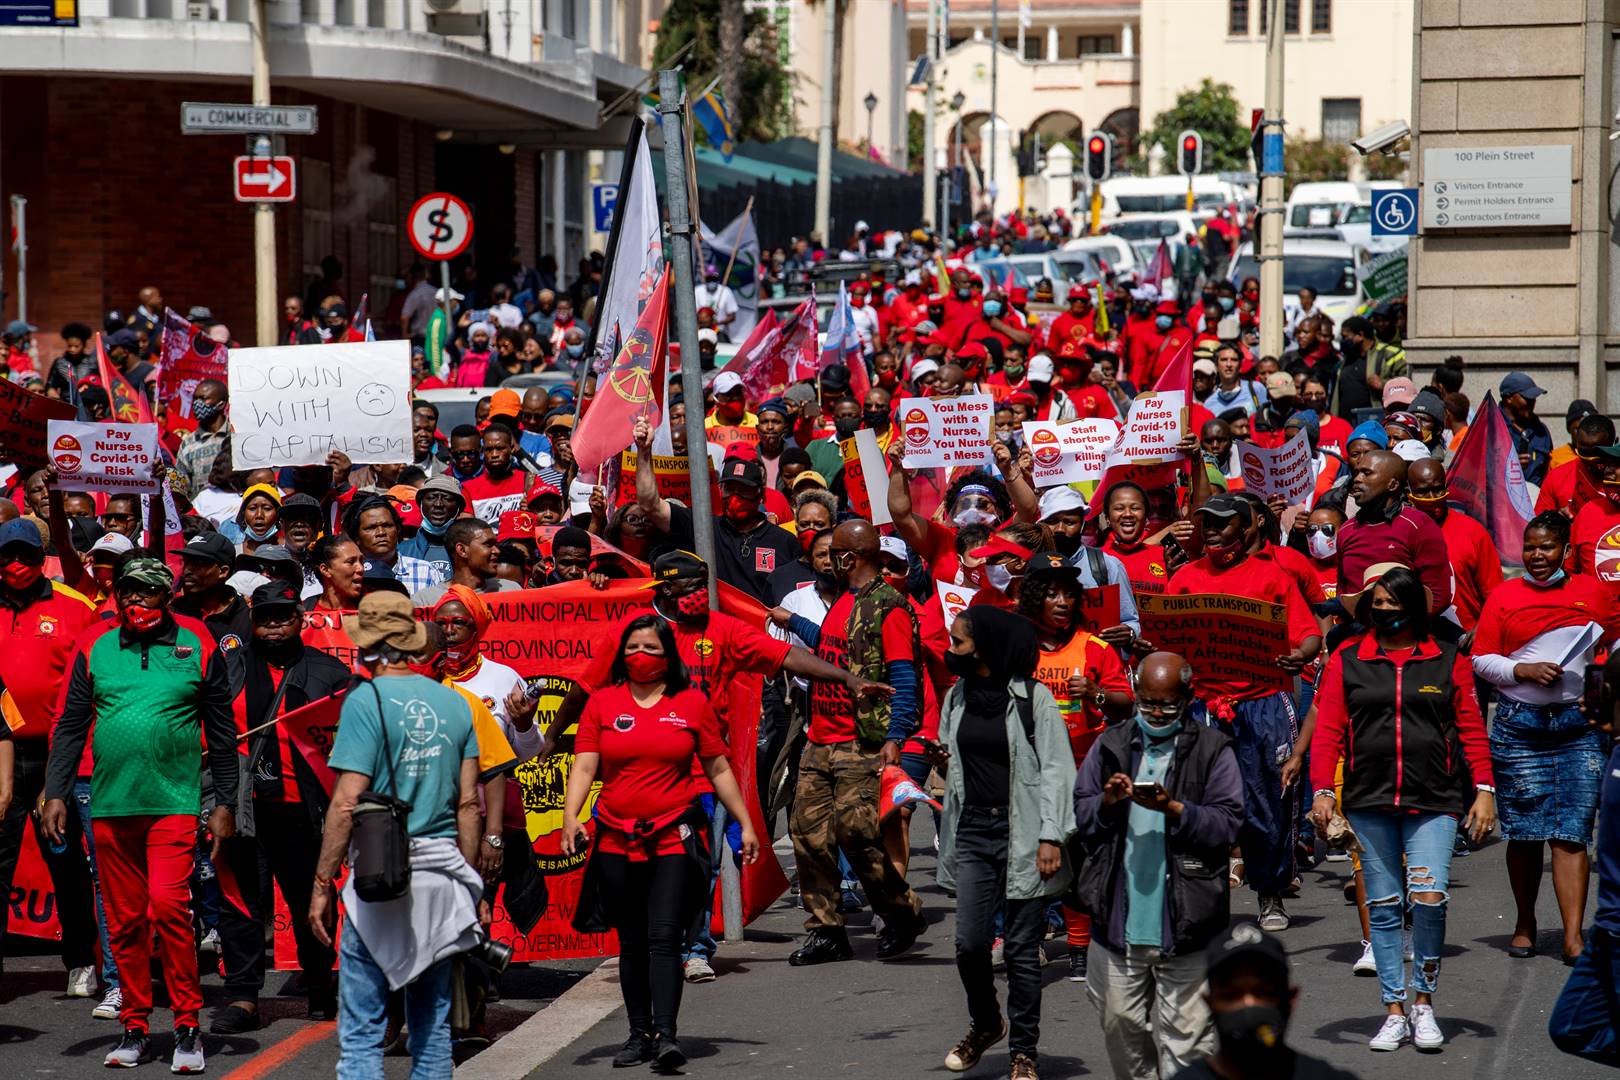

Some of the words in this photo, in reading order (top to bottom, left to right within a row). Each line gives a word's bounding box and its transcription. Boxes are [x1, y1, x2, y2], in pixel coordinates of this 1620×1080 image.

[208, 110, 291, 127] COMMERCIAL
[1455, 152, 1472, 161] 100
[1475, 151, 1500, 161] Plein
[1503, 150, 1536, 161] Street
[1454, 182, 1485, 190] Visitors
[1487, 181, 1524, 189] Entrance
[601, 187, 618, 208] P
[1454, 198, 1481, 206] Permit
[1484, 197, 1515, 205] Holders
[1518, 196, 1554, 204] Entrance
[1454, 213, 1501, 222] Contractors
[1504, 212, 1541, 220] Entrance
[428, 209, 453, 242] S
[235, 364, 342, 392] DOWN
[932, 403, 954, 413] You
[957, 402, 989, 411] Mess
[1145, 399, 1164, 409] Pay
[252, 397, 331, 428] WITH
[1136, 411, 1173, 421] Nurses
[943, 414, 968, 424] with
[943, 427, 981, 437] Nurse,
[1071, 425, 1097, 435] Staff
[1131, 420, 1177, 433] Covid-19
[106, 429, 132, 441] Pay
[730, 429, 758, 441] Dem
[1062, 434, 1111, 445] shortage
[1140, 434, 1165, 443] Risk
[95, 441, 143, 451] Nurses
[241, 433, 404, 462] CAPITALISM
[933, 439, 955, 448] You
[958, 438, 991, 447] Nurse
[906, 448, 932, 456] DENOSA
[954, 450, 985, 460] Mess
[1124, 446, 1177, 457] Allowanc
[1270, 447, 1297, 465] Time
[1297, 440, 1305, 450] to
[90, 453, 149, 464] Covid-19
[1074, 453, 1106, 463] killing
[1269, 450, 1308, 477] Respect
[652, 458, 690, 471] TRANSPOR
[1084, 463, 1102, 471] Us!
[104, 465, 136, 476] Risk
[1035, 468, 1064, 478] DENOSA
[85, 475, 156, 488] Allowance
[1274, 466, 1308, 489] Nurses
[661, 479, 690, 489] Dem
[1289, 476, 1312, 498] Now!
[487, 601, 600, 622] MUNICIPAL
[1163, 597, 1200, 611] PUBLIC
[1203, 597, 1263, 616] TRANSPORT
[1142, 618, 1213, 632] COSATU
[1218, 618, 1285, 641] Demand
[1160, 634, 1202, 646] Safe,
[1208, 632, 1272, 653] Reliable
[477, 639, 595, 660] PROVINCIAL
[1210, 662, 1284, 686] Transport
[547, 861, 556, 870] IS
[556, 859, 569, 870] AN
